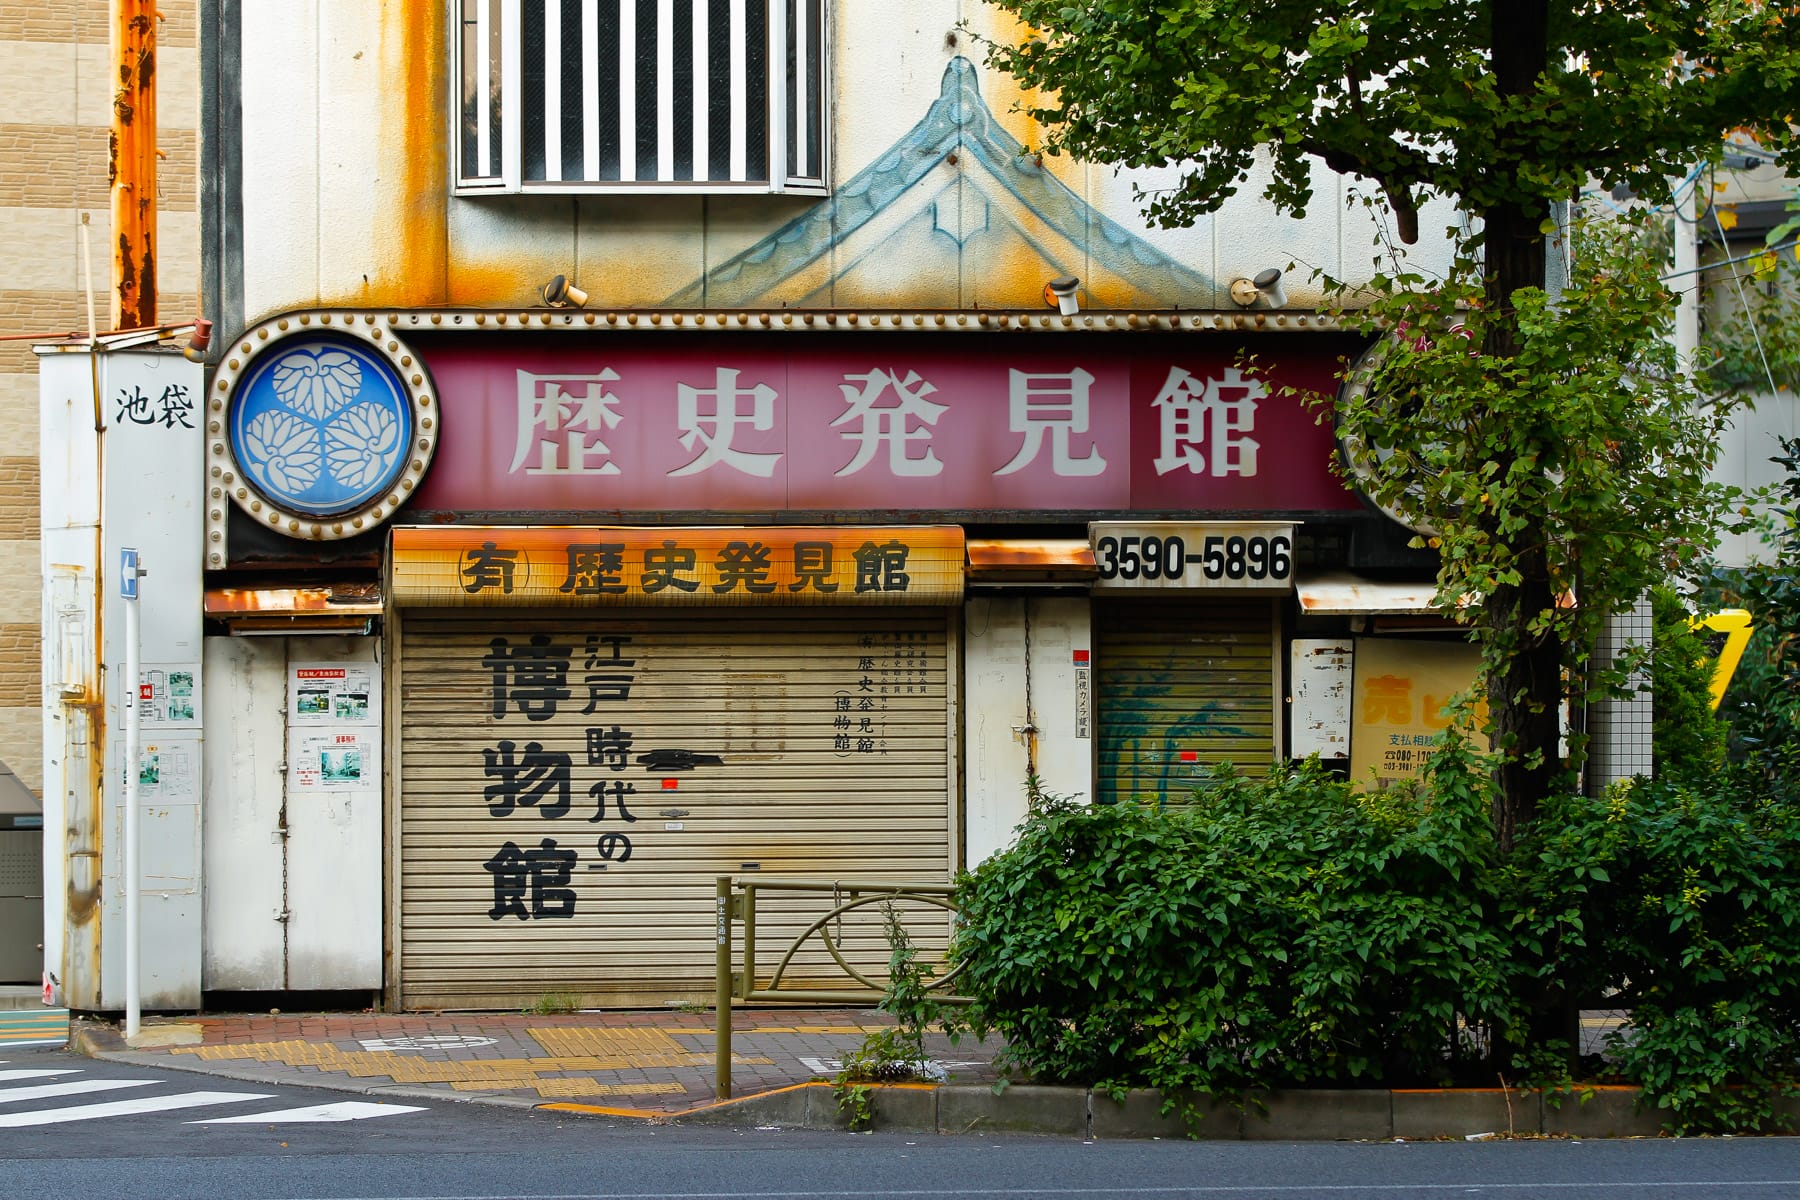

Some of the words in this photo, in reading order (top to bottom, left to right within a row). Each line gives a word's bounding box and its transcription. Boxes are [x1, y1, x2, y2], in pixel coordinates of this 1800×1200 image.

[116, 384, 195, 430] 池袋
[508, 365, 1268, 478] 歴史発見館
[1097, 536, 1291, 580] 3590-5896
[482, 634, 578, 921] 博物館
[580, 636, 638, 863] 江戸時代の
